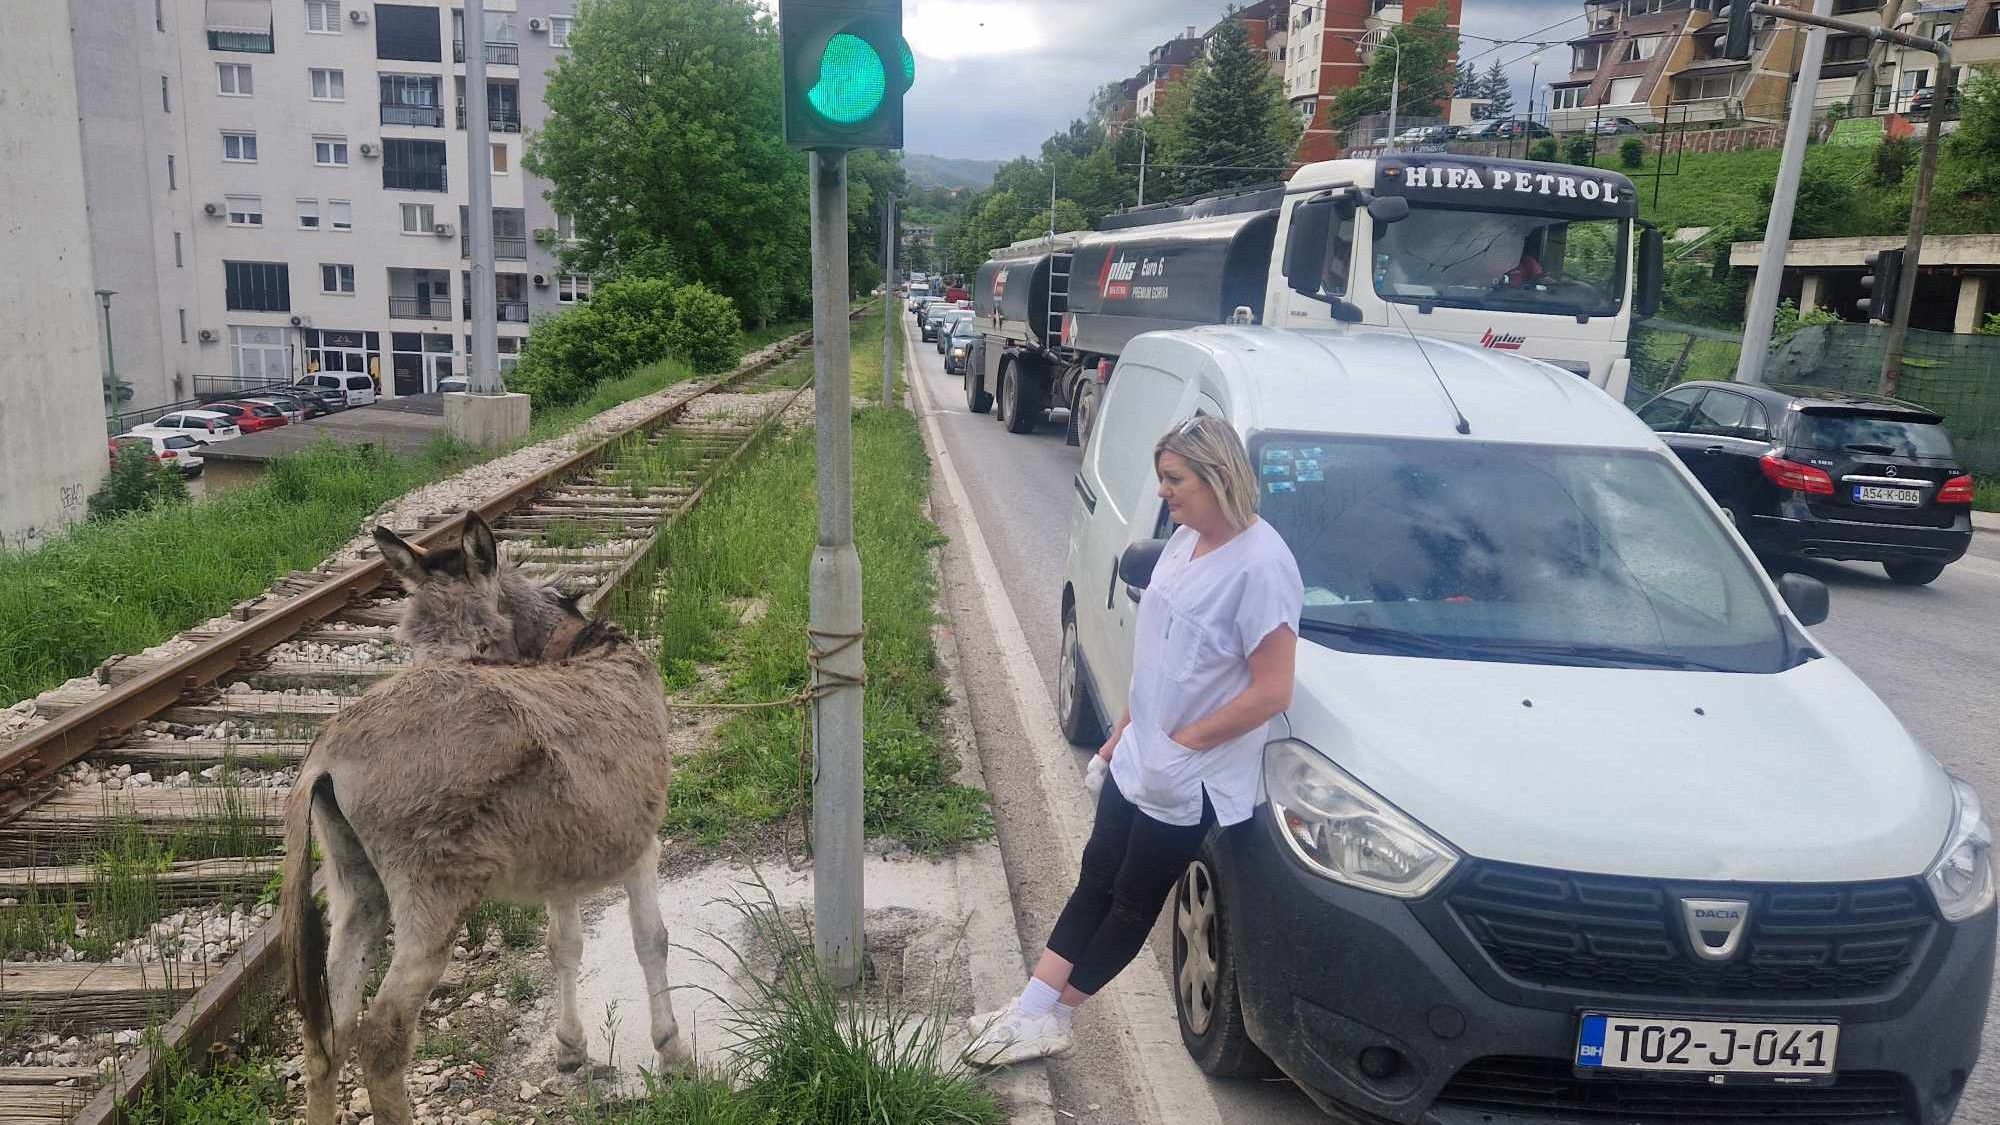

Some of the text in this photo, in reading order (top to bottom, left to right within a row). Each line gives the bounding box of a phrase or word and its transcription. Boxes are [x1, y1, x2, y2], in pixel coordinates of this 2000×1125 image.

[1405, 166, 1620, 204] HIFA PETROL
[1141, 256, 1165, 277] Euro 6
[1863, 487, 1918, 502] A54-K-086
[1695, 909, 1740, 919] DACIA
[1580, 1024, 1827, 1068] BIH T02-J-041
